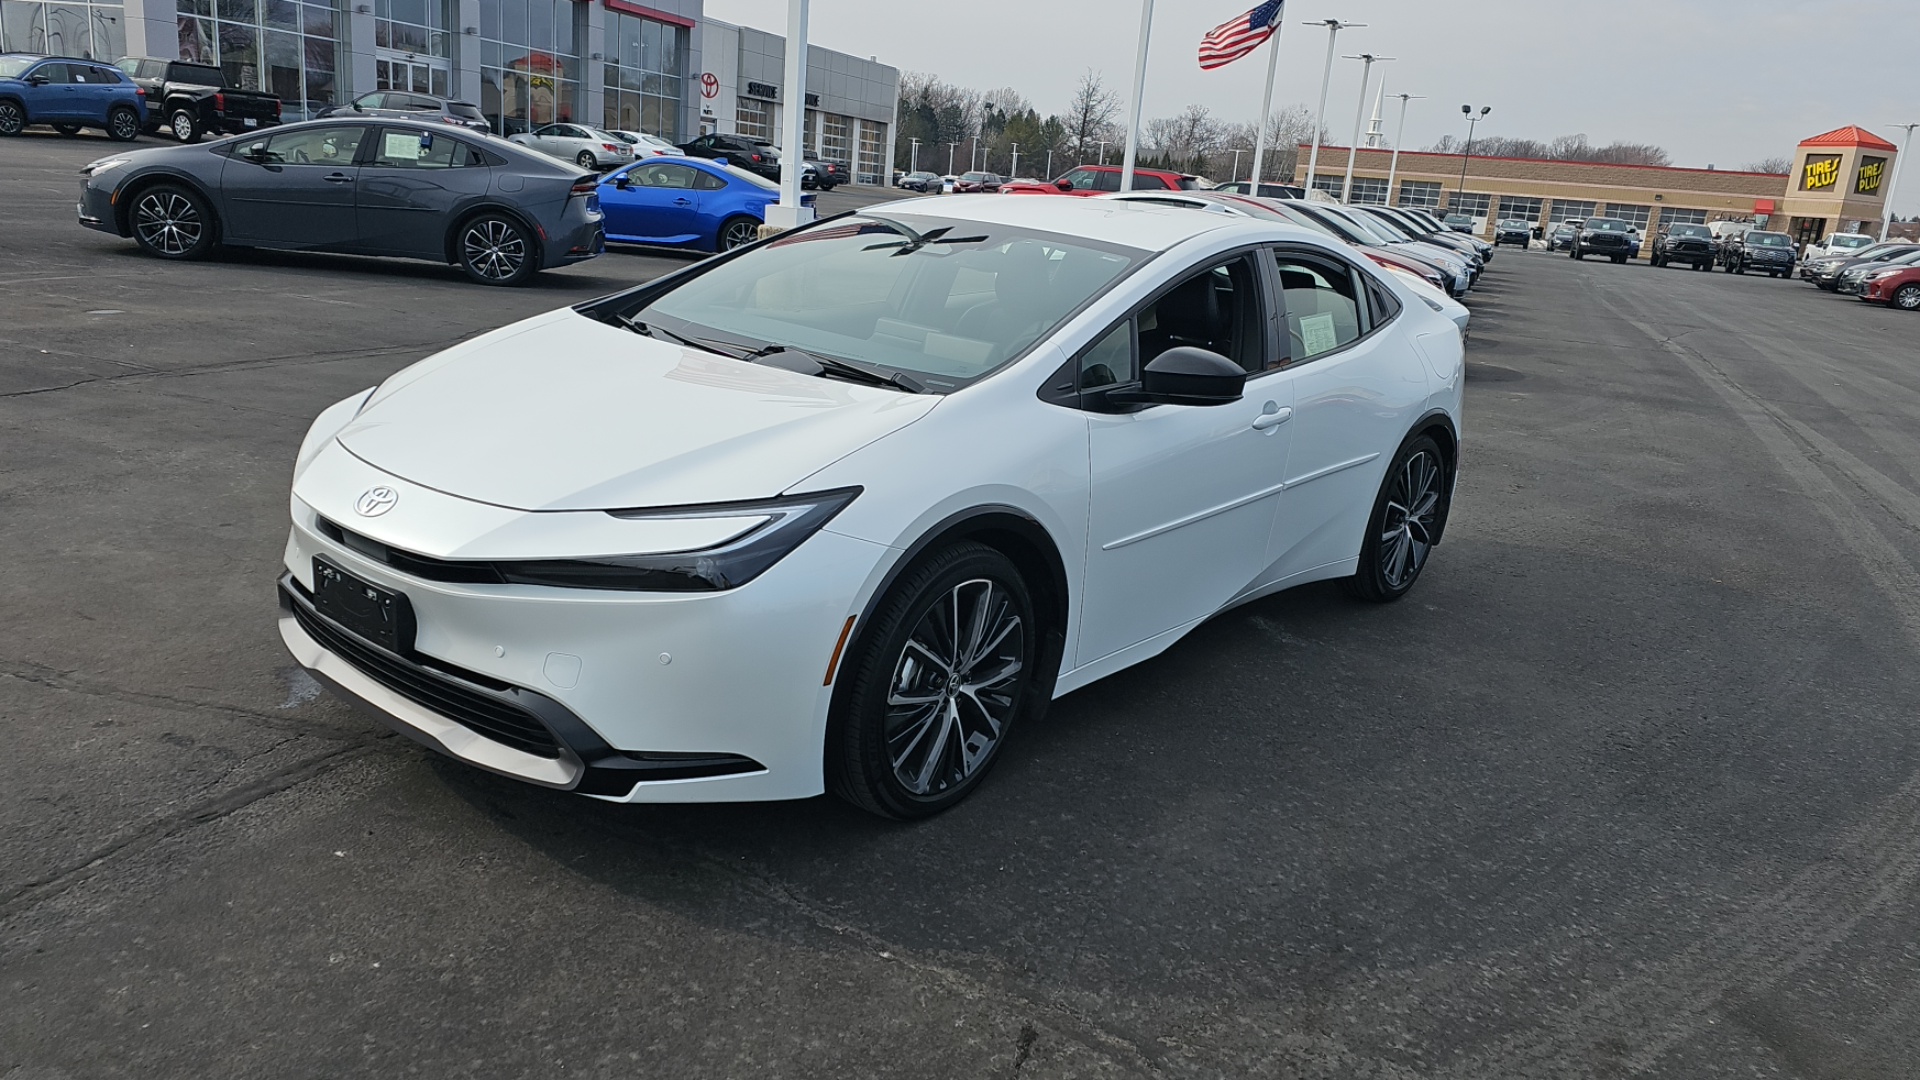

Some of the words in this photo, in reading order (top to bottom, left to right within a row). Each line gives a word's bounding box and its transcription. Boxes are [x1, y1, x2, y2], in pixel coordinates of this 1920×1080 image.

[748, 82, 778, 99] SERVICE
[1806, 157, 1840, 177] TIRES
[1859, 161, 1885, 179] TIRES
[1807, 170, 1838, 189] PLUS
[1859, 174, 1882, 192] PLUS
